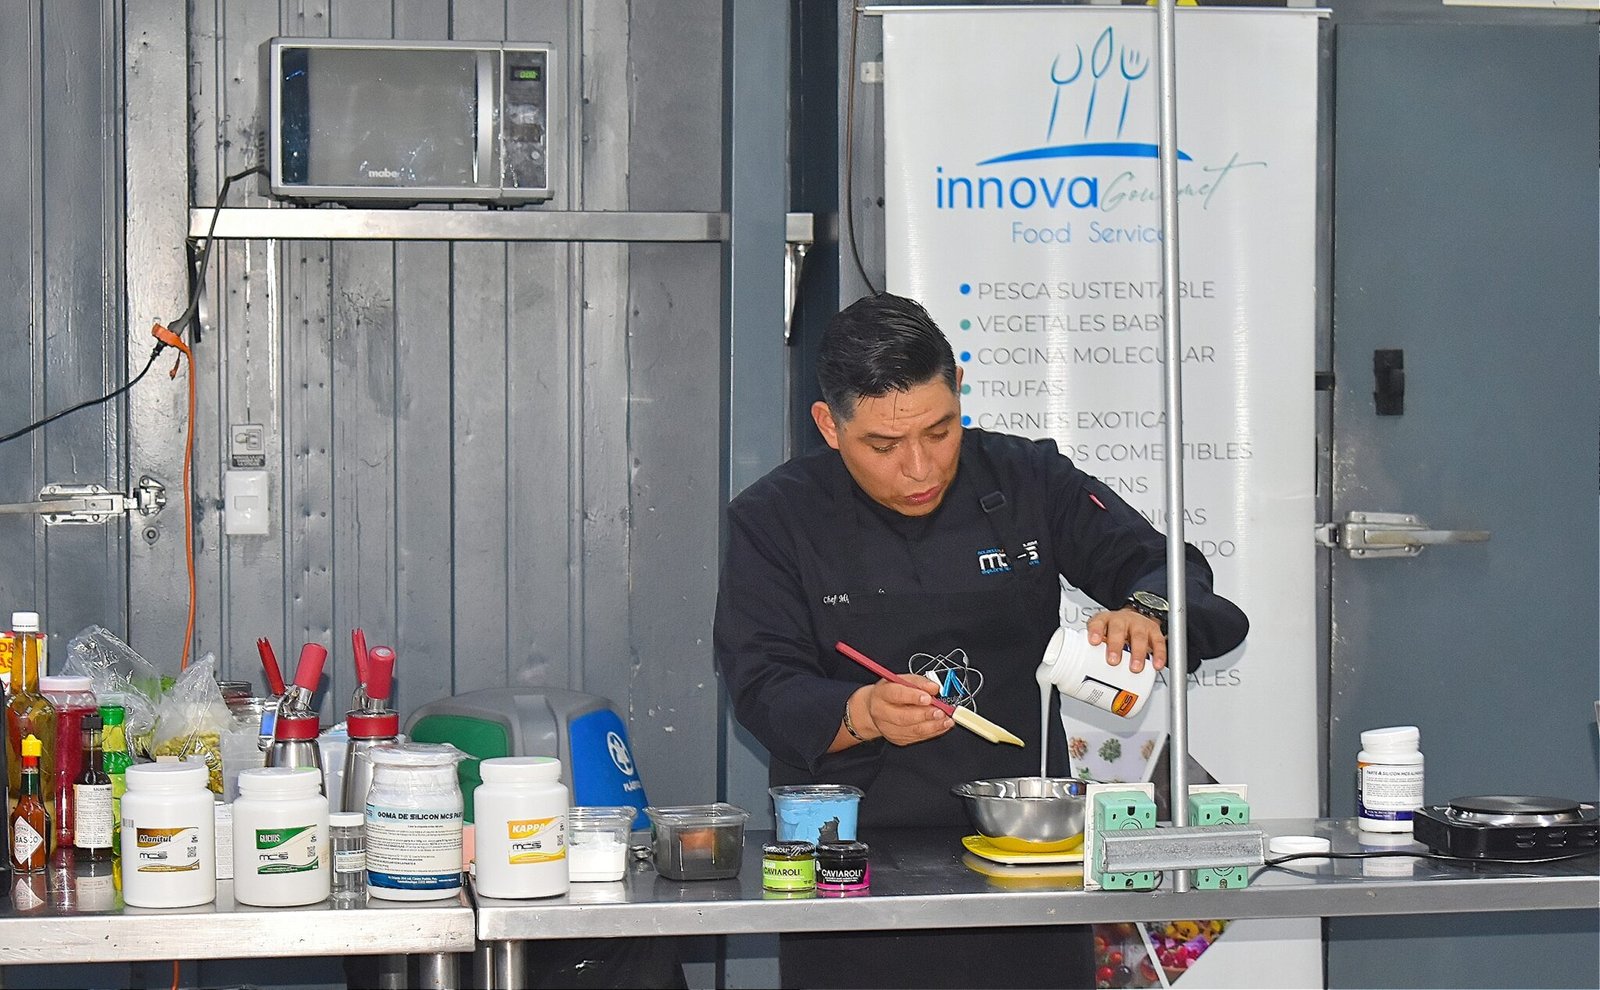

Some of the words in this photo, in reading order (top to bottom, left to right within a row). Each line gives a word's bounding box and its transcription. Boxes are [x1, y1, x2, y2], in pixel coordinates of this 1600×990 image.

[936, 167, 1099, 209] innova
[1100, 152, 1267, 213] Goumet
[1012, 221, 1071, 244] Food
[978, 282, 1050, 300] PESCA
[976, 314, 1106, 333] VEGETALES
[977, 346, 1066, 366] COCINA
[1073, 345, 1216, 364] MOLECUAR
[977, 379, 1065, 398] TRUFAS
[977, 411, 1070, 430] CARNES
[1077, 410, 1184, 429] EXOTICA
[1095, 442, 1254, 462] COMETIBLES
[377, 811, 397, 820] GOMA
[440, 812, 453, 820] MCS
[512, 822, 545, 833] KAPPA
[764, 866, 801, 877] CAVIAROLI
[821, 868, 862, 878] CAVIAROLI
